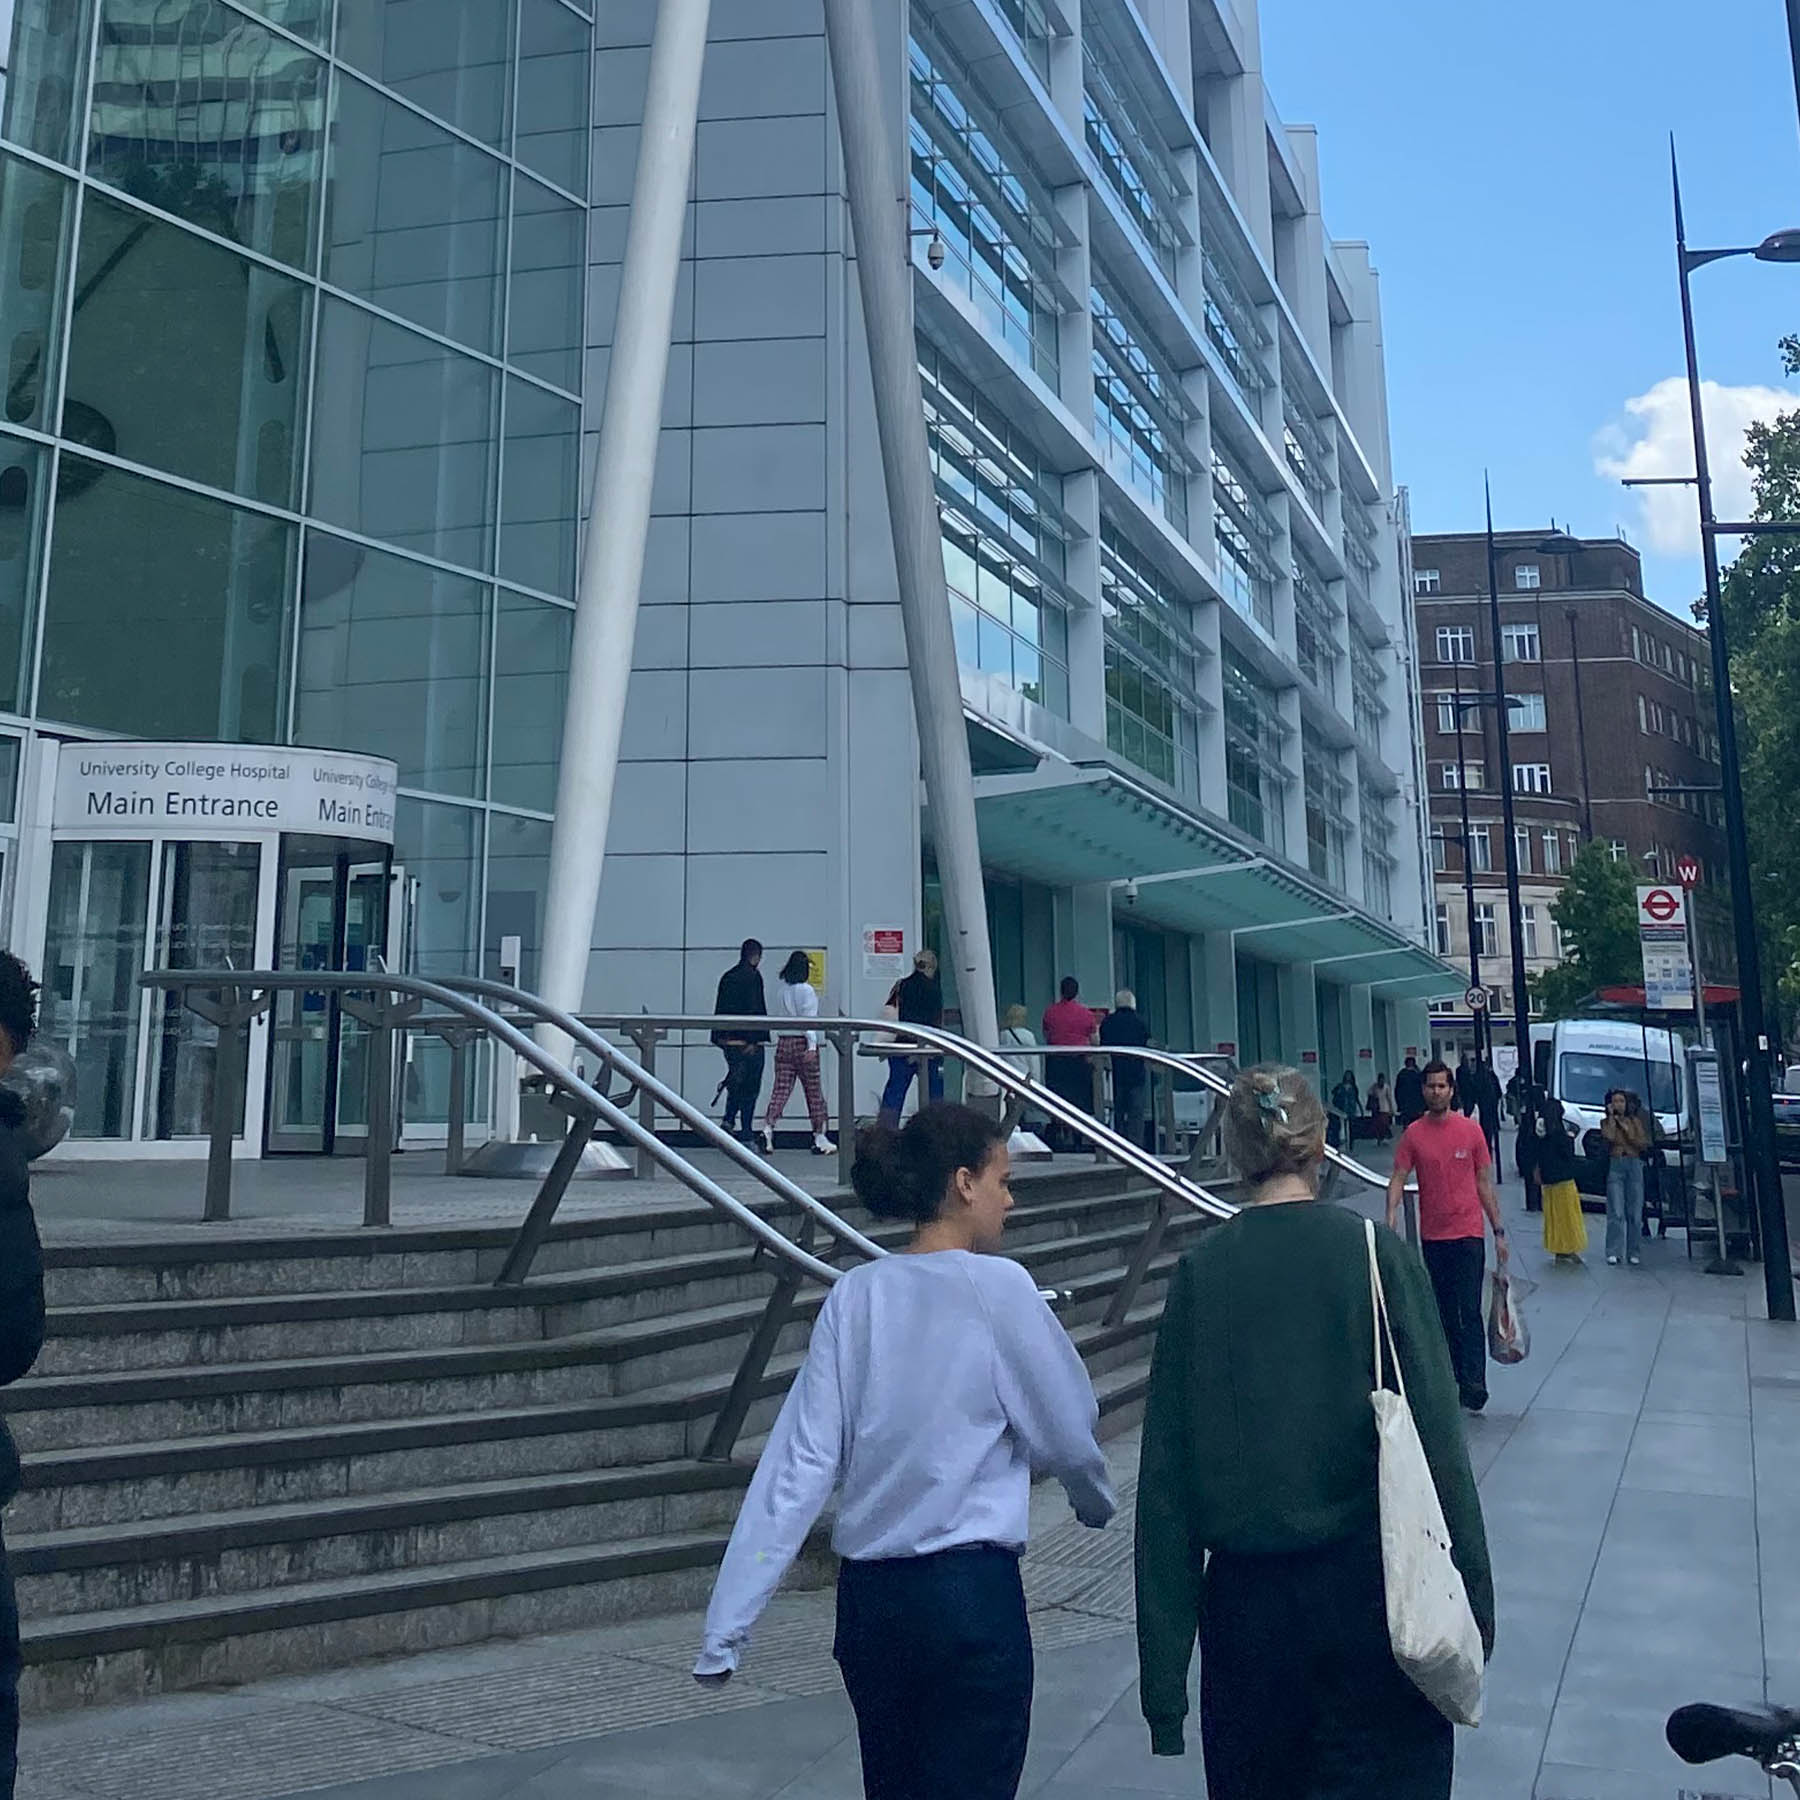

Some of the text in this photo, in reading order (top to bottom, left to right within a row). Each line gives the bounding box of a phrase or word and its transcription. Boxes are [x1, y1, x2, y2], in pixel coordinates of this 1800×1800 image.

[80, 760, 290, 783] University College Hospital
[313, 767, 363, 791] University
[87, 790, 279, 818] Main Entrance
[319, 797, 361, 824] Main
[1678, 865, 1697, 882] W
[1468, 992, 1484, 1004] 20
